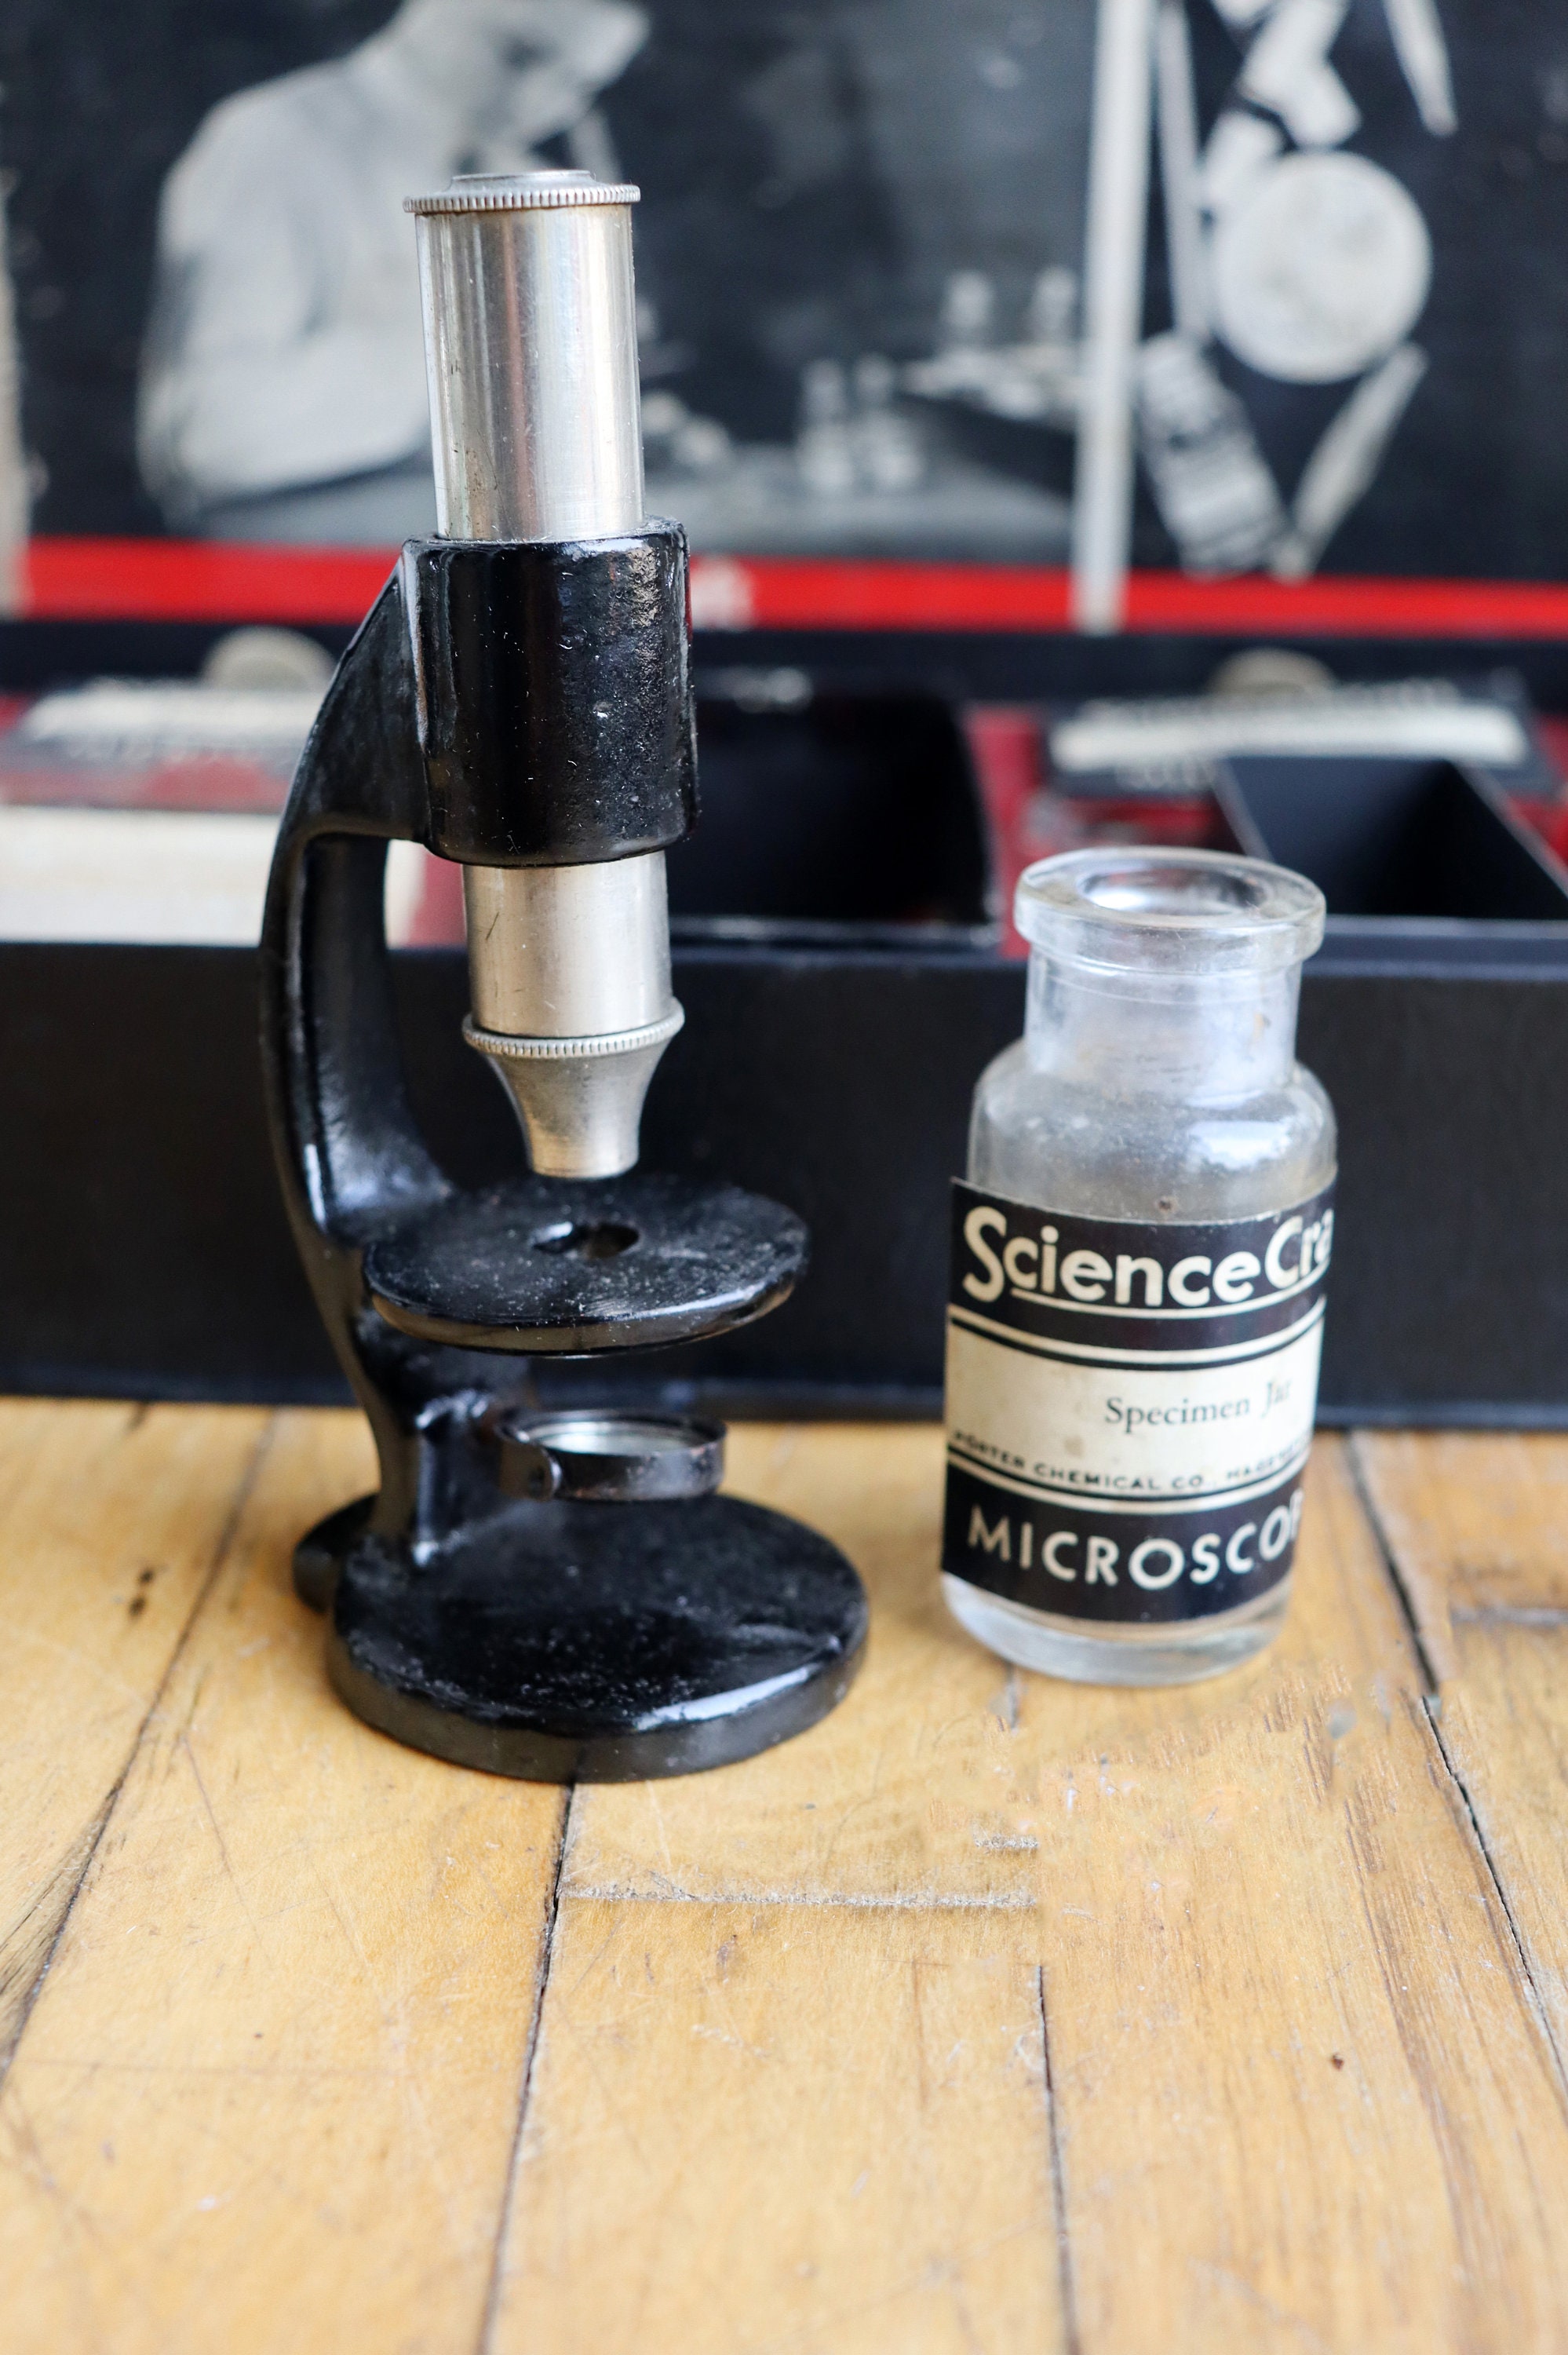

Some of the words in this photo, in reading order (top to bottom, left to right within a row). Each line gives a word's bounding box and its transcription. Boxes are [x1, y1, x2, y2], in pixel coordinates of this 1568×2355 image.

[1104, 1397, 1250, 1433] Specimen
[1260, 1378, 1293, 1418] Jar
[1034, 1462, 1161, 1491] CHEMICAL
